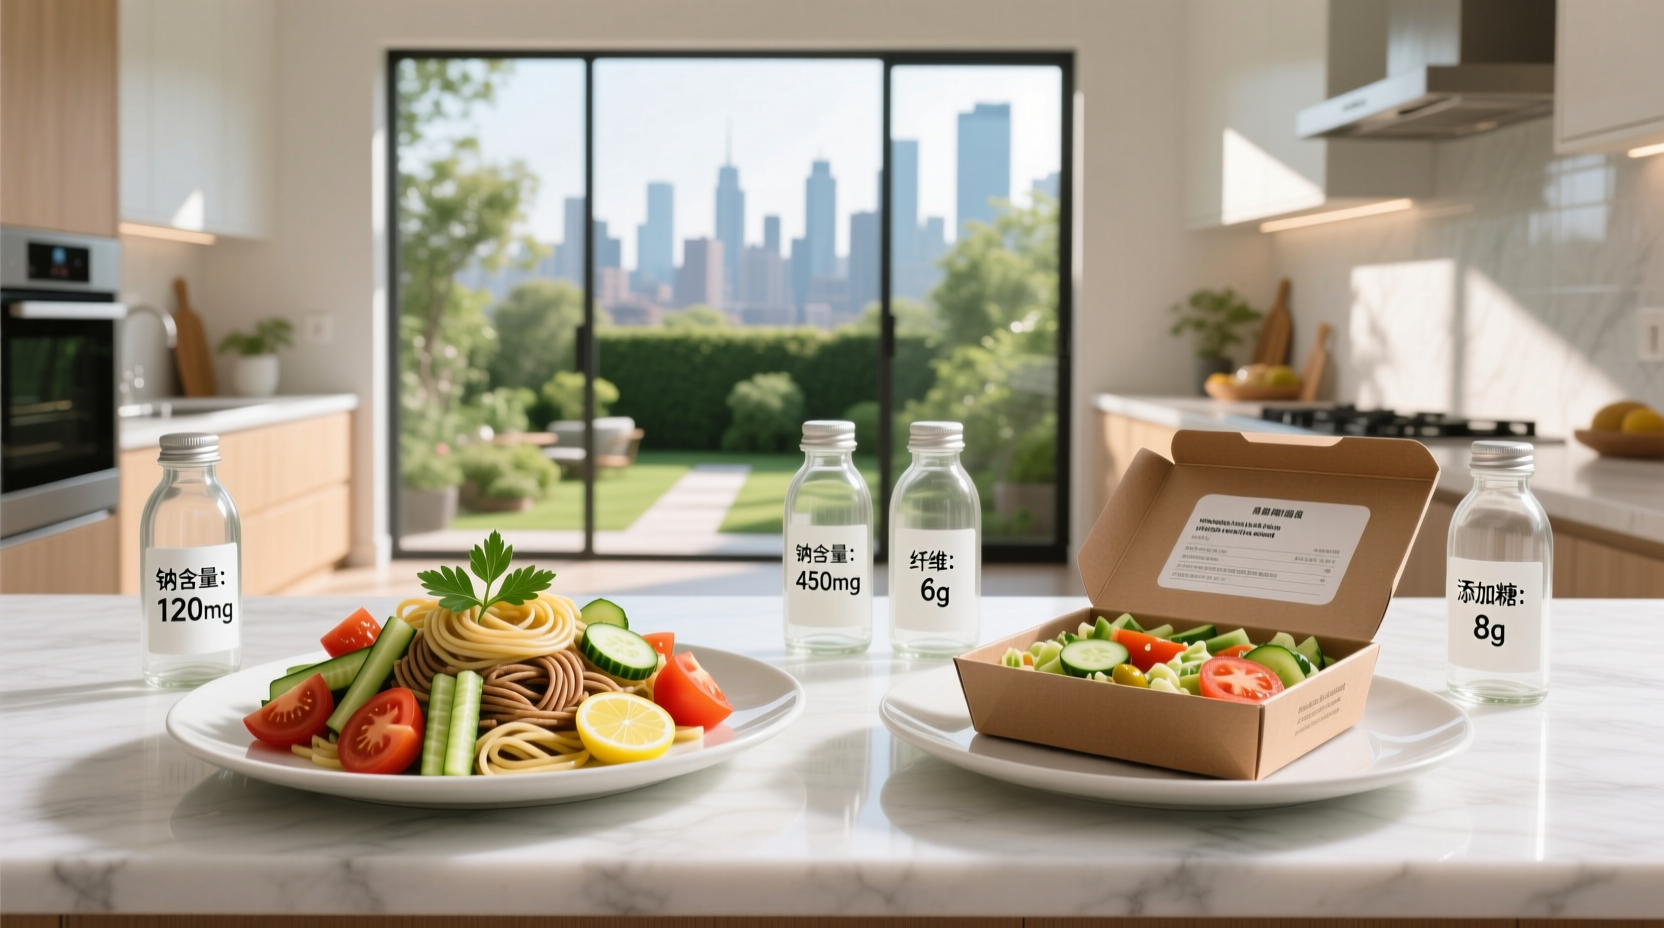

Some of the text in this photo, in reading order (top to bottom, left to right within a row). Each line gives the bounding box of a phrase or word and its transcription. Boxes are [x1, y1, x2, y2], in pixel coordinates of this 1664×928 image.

[796, 543, 854, 563] 钠含量:
[909, 550, 954, 572] 纤维:
[156, 567, 225, 591] 钠含量:
[795, 571, 861, 596] 450mg
[920, 577, 950, 608] 6g
[1457, 579, 1525, 607] 添加糖:
[157, 596, 233, 624] 120mg
[1473, 614, 1505, 647] 8g
